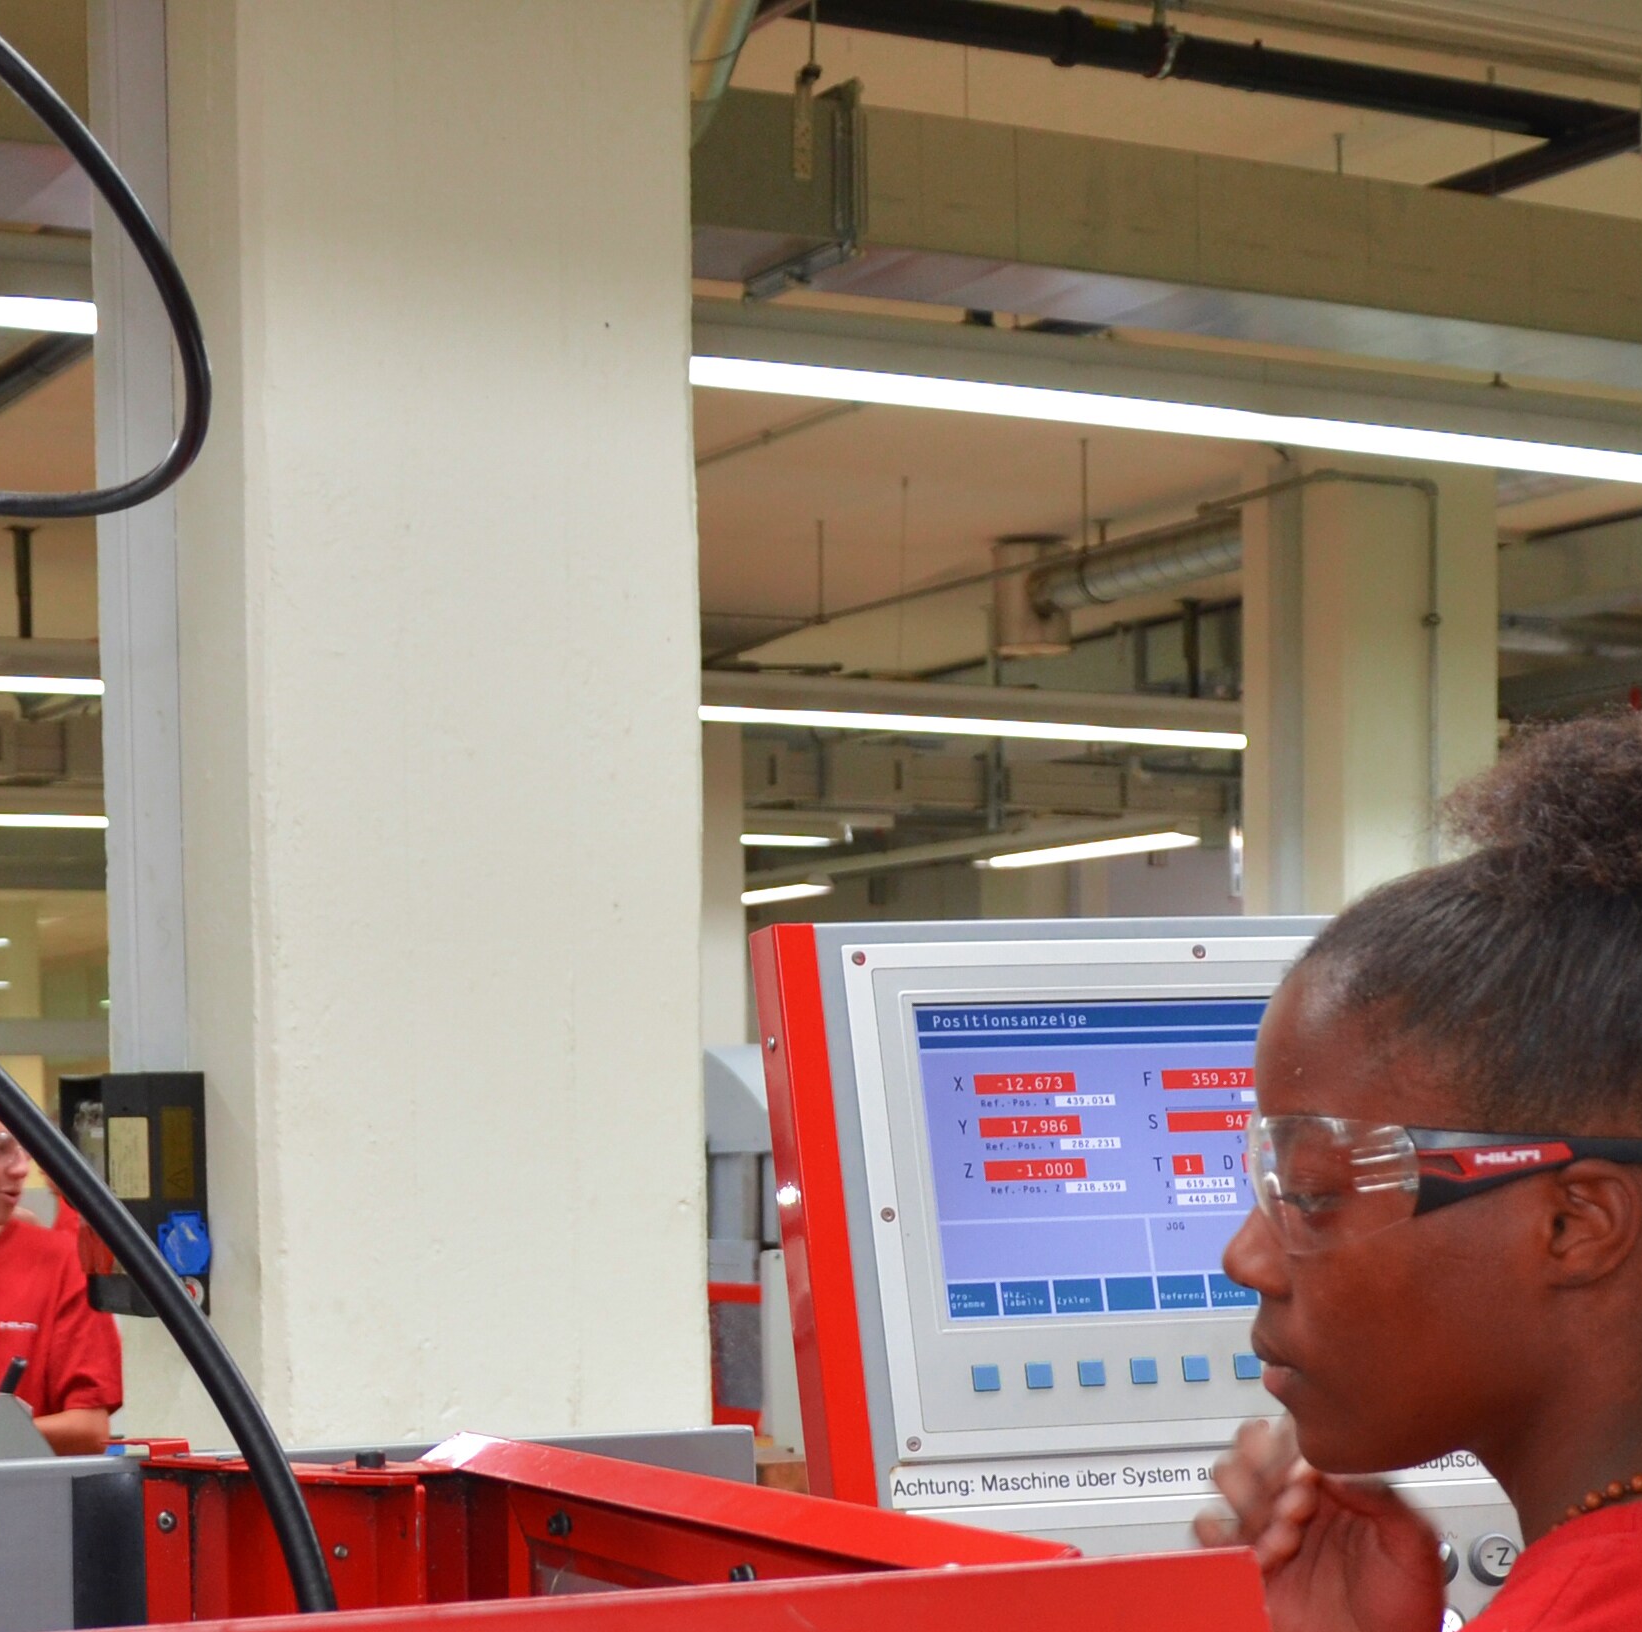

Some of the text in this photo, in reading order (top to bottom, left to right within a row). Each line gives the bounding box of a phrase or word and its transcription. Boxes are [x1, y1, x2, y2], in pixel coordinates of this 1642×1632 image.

[932, 1013, 1087, 1029] Positionsanzeige
[953, 1076, 1063, 1092] X -12.673
[1143, 1071, 1247, 1087] F 359.37
[958, 1119, 1068, 1135] Y 17.986
[1148, 1113, 1158, 1130] S
[1153, 1155, 1233, 1172] T 1 D
[1475, 1149, 1541, 1164] HILTI
[964, 1162, 1074, 1179] Z -1.000
[893, 1477, 975, 1496] Achtung:
[981, 1472, 1070, 1491] Maschine
[1076, 1468, 1116, 1487] über
[1122, 1465, 1190, 1485] System
